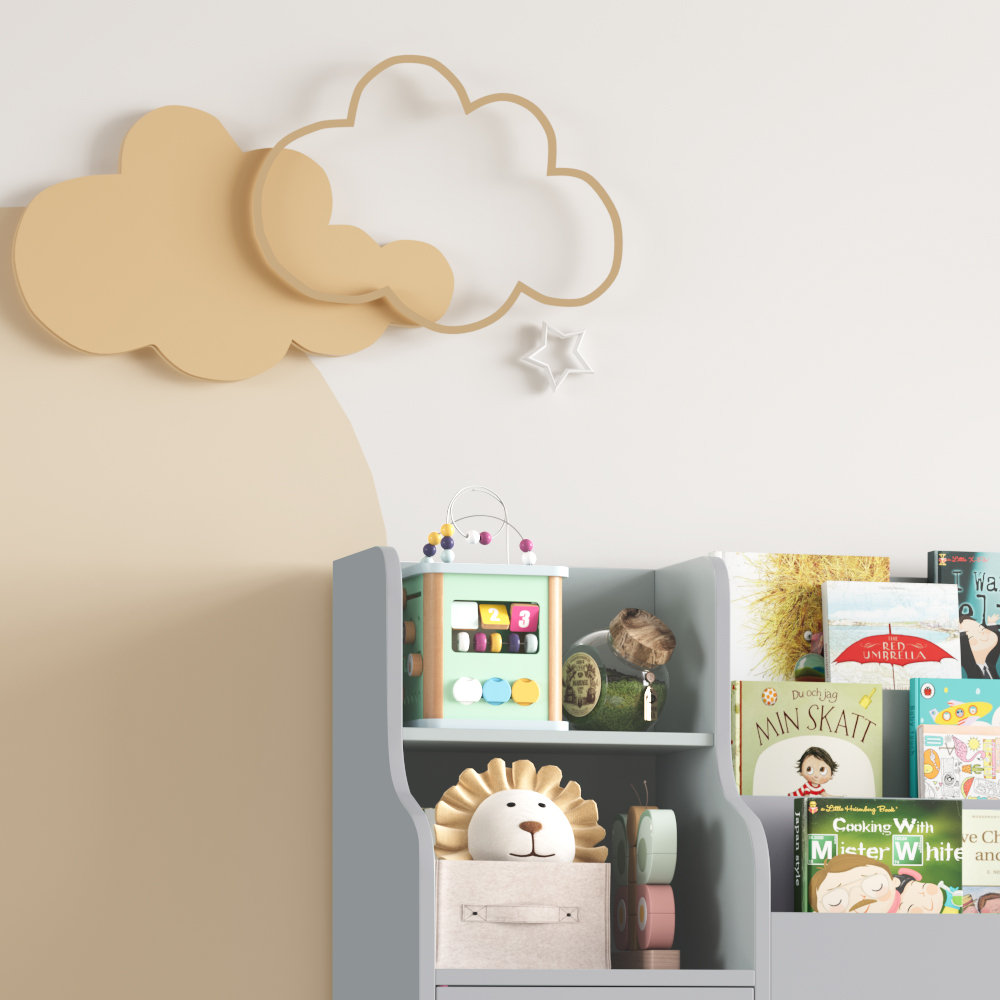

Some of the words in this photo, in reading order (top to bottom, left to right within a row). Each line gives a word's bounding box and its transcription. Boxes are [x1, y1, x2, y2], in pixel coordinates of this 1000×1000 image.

[952, 570, 963, 592] I
[488, 608, 500, 621] 2
[518, 610, 531, 628] 3
[882, 641, 906, 651] RED
[863, 651, 927, 660] UMBRELLA
[792, 689, 804, 700] Du
[806, 688, 821, 697] och
[818, 689, 838, 703] jag
[755, 707, 800, 746] MIN
[806, 704, 877, 743] SKATT
[825, 804, 844, 813] Little
[832, 817, 892, 835] Cooking
[893, 818, 934, 834] With
[810, 839, 891, 862] Mister
[894, 841, 963, 863] White
